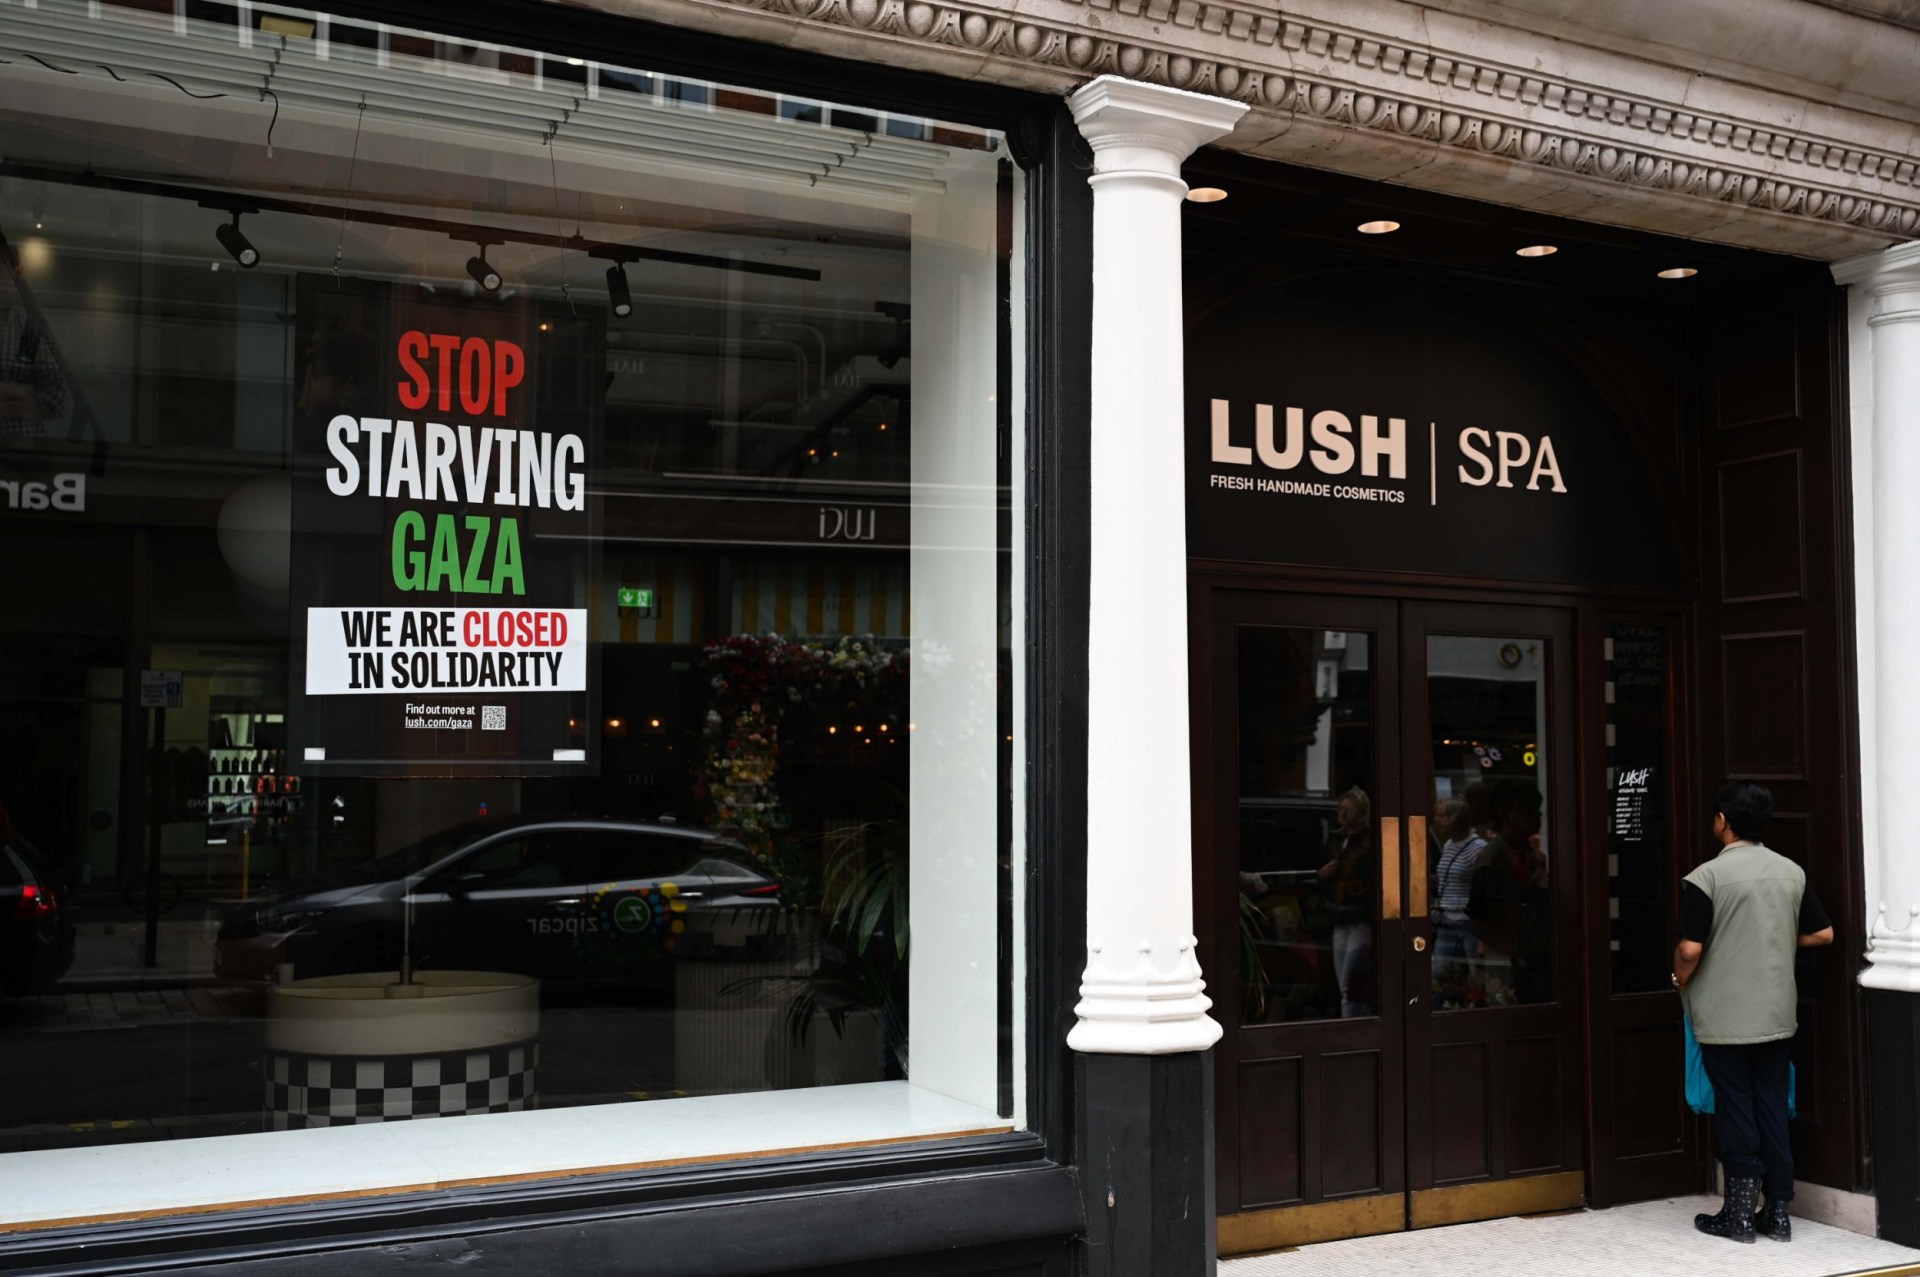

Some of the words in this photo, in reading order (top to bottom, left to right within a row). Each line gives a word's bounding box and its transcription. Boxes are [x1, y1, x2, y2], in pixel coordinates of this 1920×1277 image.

[398, 331, 525, 416] STOP
[326, 415, 585, 512] STARVING
[1211, 399, 1406, 480] LUSH
[1458, 426, 1568, 494] SPA
[1210, 474, 1254, 491] FRESH
[1256, 478, 1331, 498] HANDMADE
[1333, 485, 1406, 504] COSMETICS
[392, 511, 526, 596] GAZA
[341, 611, 392, 648] WE
[399, 611, 457, 648] ARE
[463, 611, 568, 648] CLOSED
[348, 652, 384, 689] IN
[391, 651, 563, 689] SOLIDARITY
[405, 703, 425, 715] Find
[425, 704, 441, 715] out
[441, 706, 466, 716] more
[466, 705, 476, 716] at
[405, 716, 473, 730] lush.com/gaza
[1618, 768, 1650, 786] LUSH
